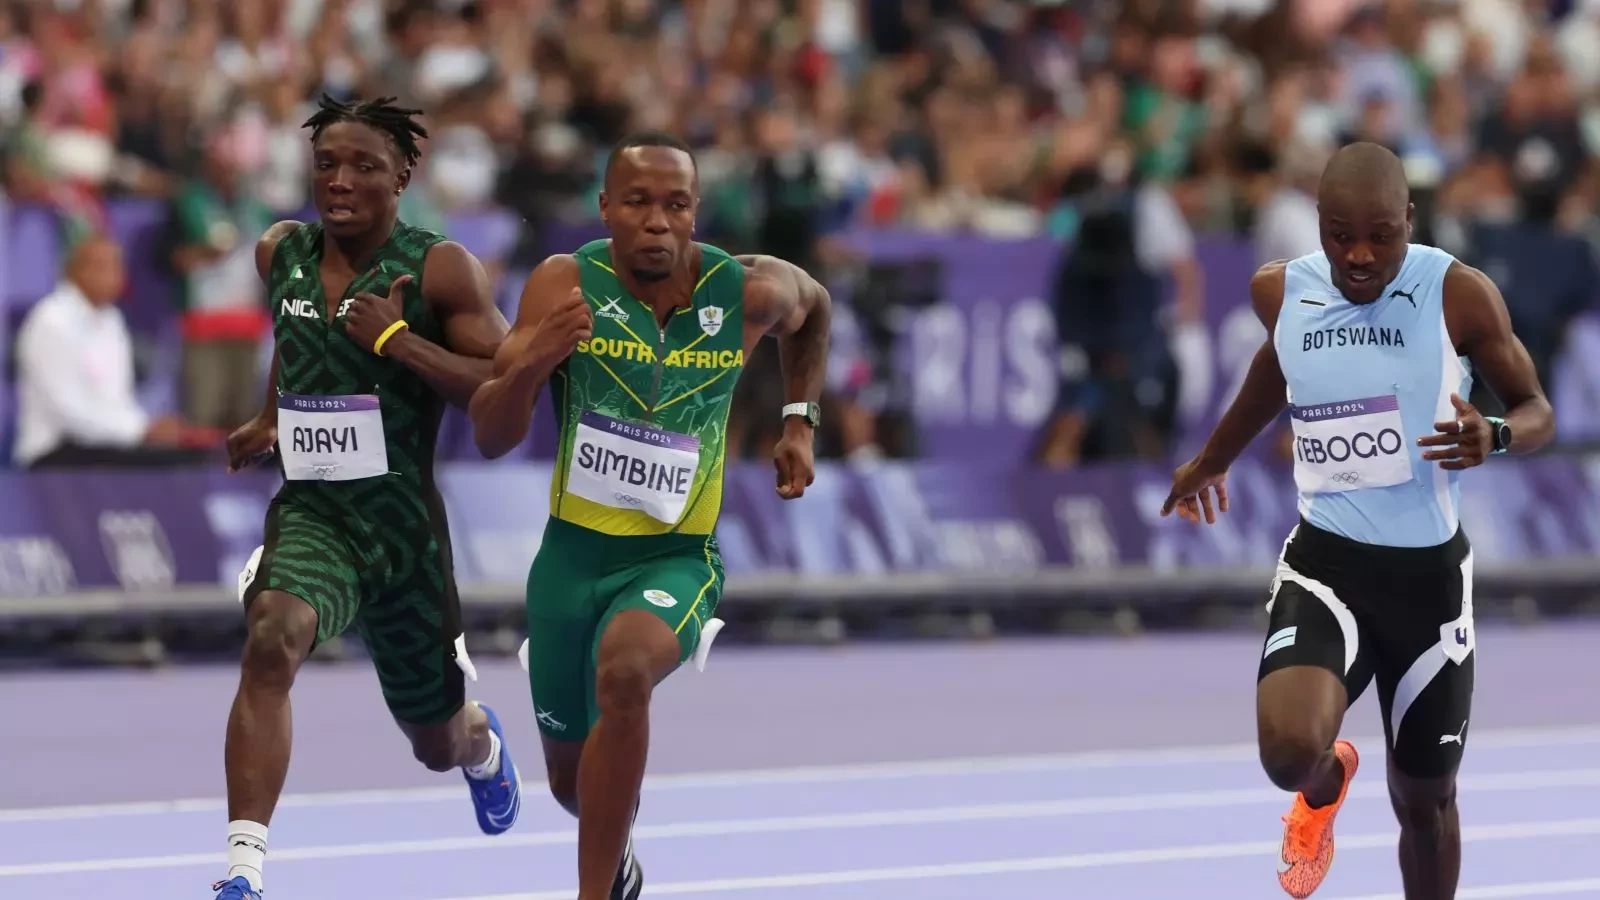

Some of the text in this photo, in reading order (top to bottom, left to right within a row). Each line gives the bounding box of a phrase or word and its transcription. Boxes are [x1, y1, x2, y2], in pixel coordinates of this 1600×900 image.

[1303, 327, 1405, 352] BOTSWANA
[576, 337, 744, 369] SOUTH AFRICA
[319, 400, 347, 409] 2024
[1335, 403, 1364, 414] 2024
[293, 426, 358, 454] AJAYI
[644, 431, 671, 444] 2024
[578, 442, 692, 495] SIMBINE
[1455, 627, 1467, 648] 4
